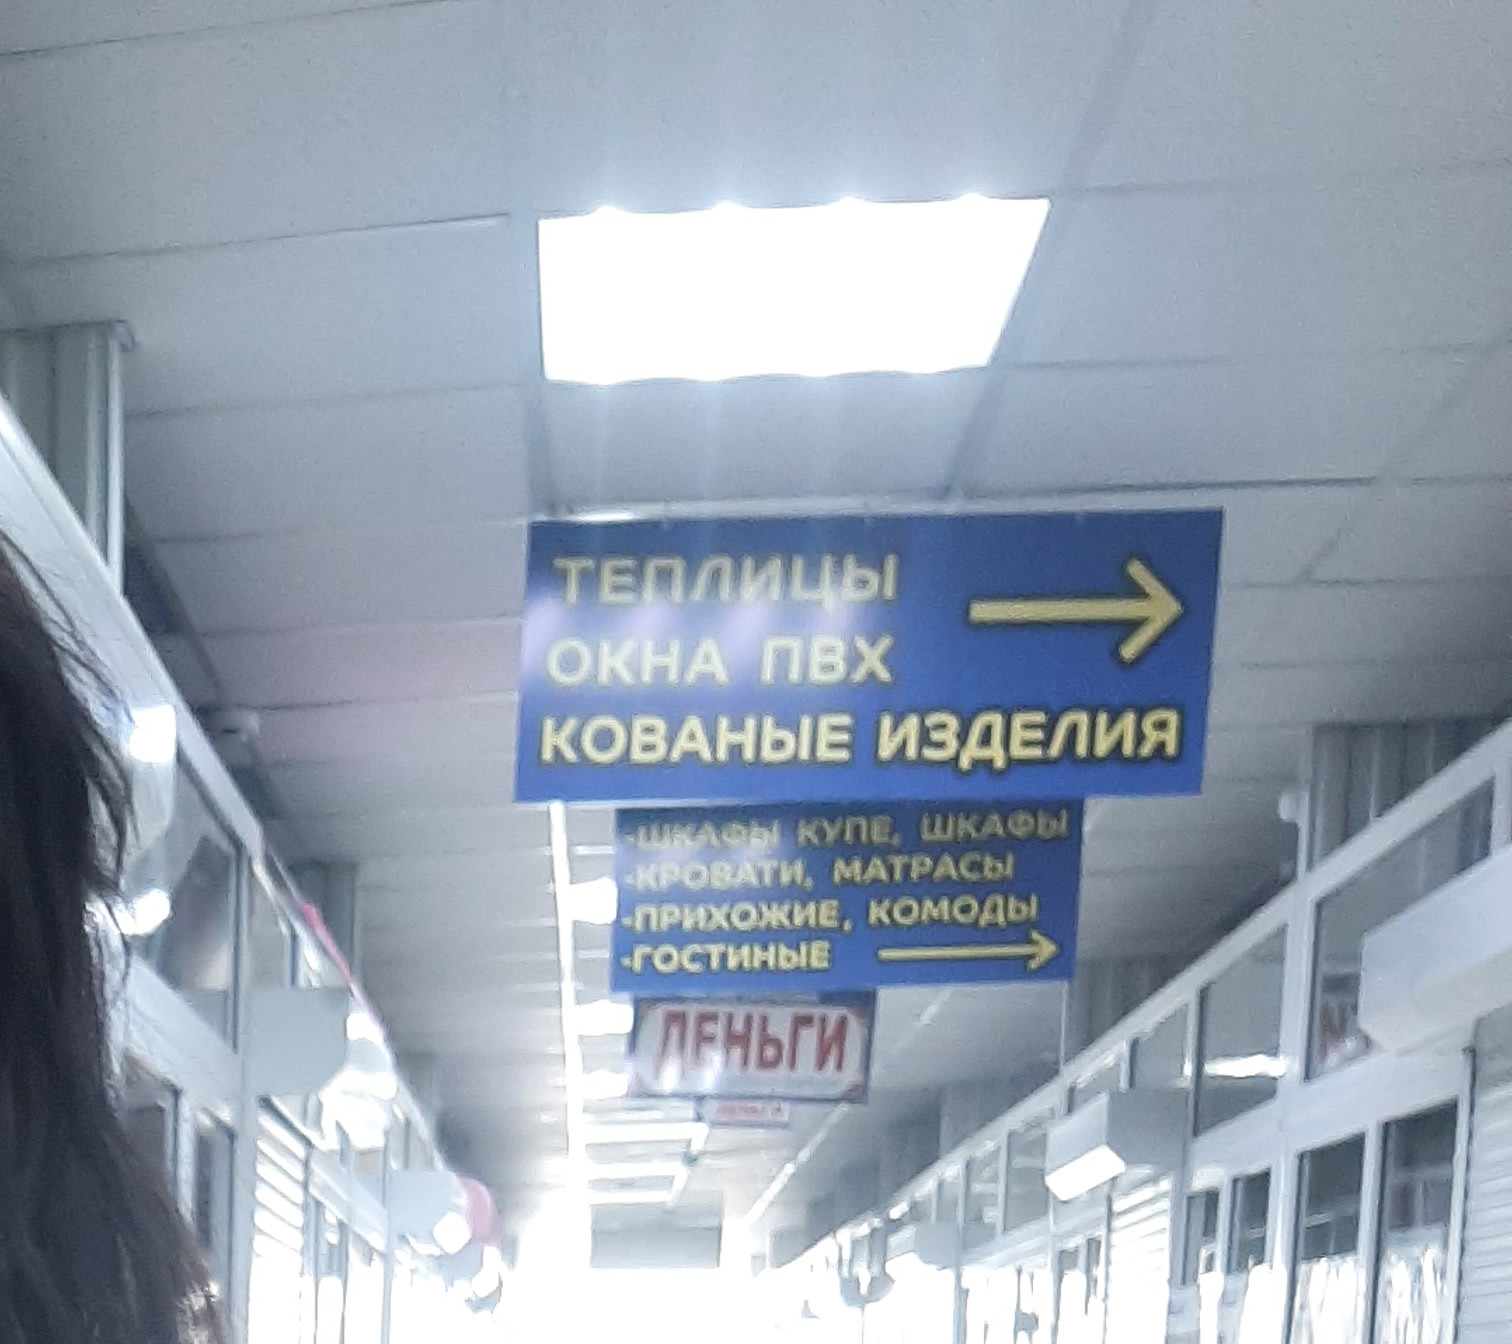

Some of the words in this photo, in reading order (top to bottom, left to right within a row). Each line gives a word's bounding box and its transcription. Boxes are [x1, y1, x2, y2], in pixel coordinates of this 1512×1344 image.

[554, 554, 899, 609] ТЕПЛИЦЫ
[545, 636, 729, 686] ОКНА
[761, 633, 894, 685] ПВХ
[539, 712, 854, 763] КОВАНЫЕ
[877, 706, 1182, 772] ИЗДЕЛИЯ
[797, 815, 902, 848] КУПЕ,
[921, 807, 1069, 843] ШКАФЫ
[832, 852, 1015, 887] МАТРАСЫ
[867, 892, 1040, 929] КОМОДЫ
[653, 1009, 849, 1080] ДЕНЬГИ
